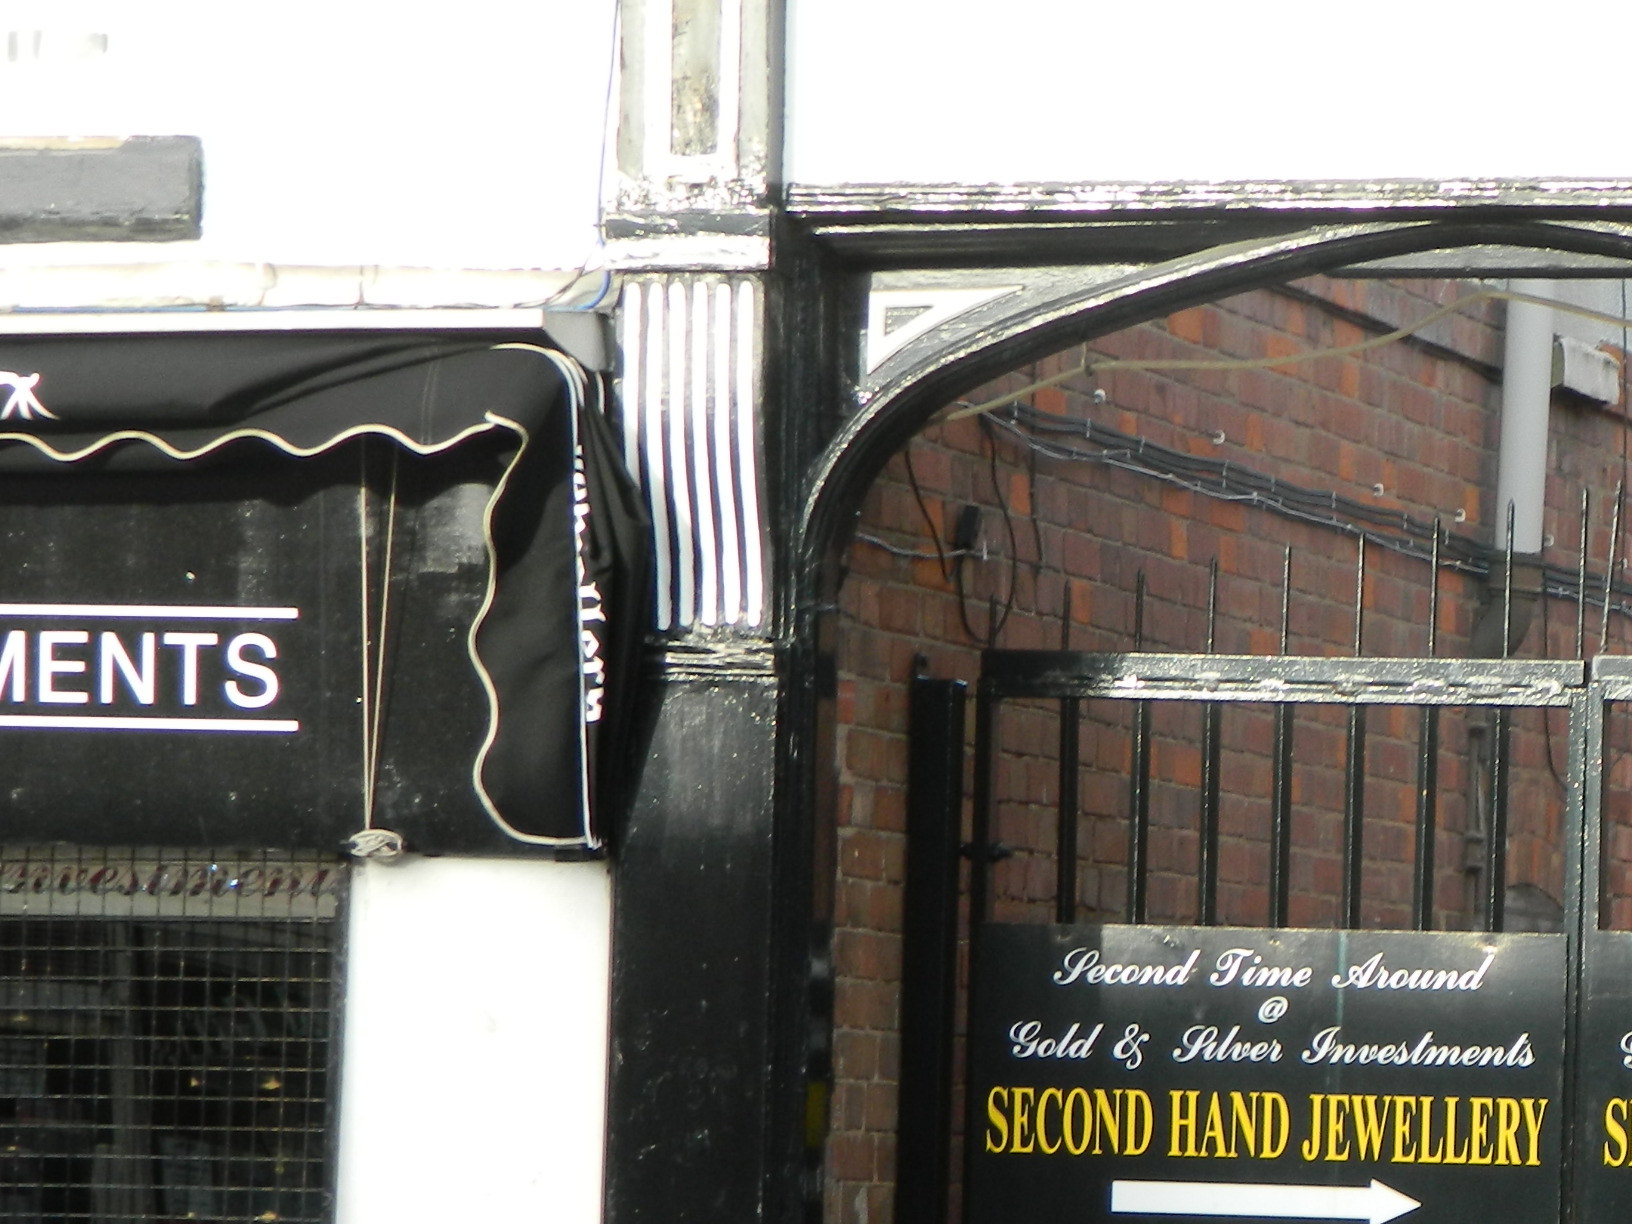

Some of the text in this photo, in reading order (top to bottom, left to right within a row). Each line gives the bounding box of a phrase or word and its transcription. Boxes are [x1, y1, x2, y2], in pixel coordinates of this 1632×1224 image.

[1053, 947, 1495, 991] Second Time Around
[1257, 995, 1289, 1023] @
[1009, 1021, 1535, 1070] Gold & Silver Investments
[985, 1085, 1549, 1167] SECOND HAND JEWELLERY
